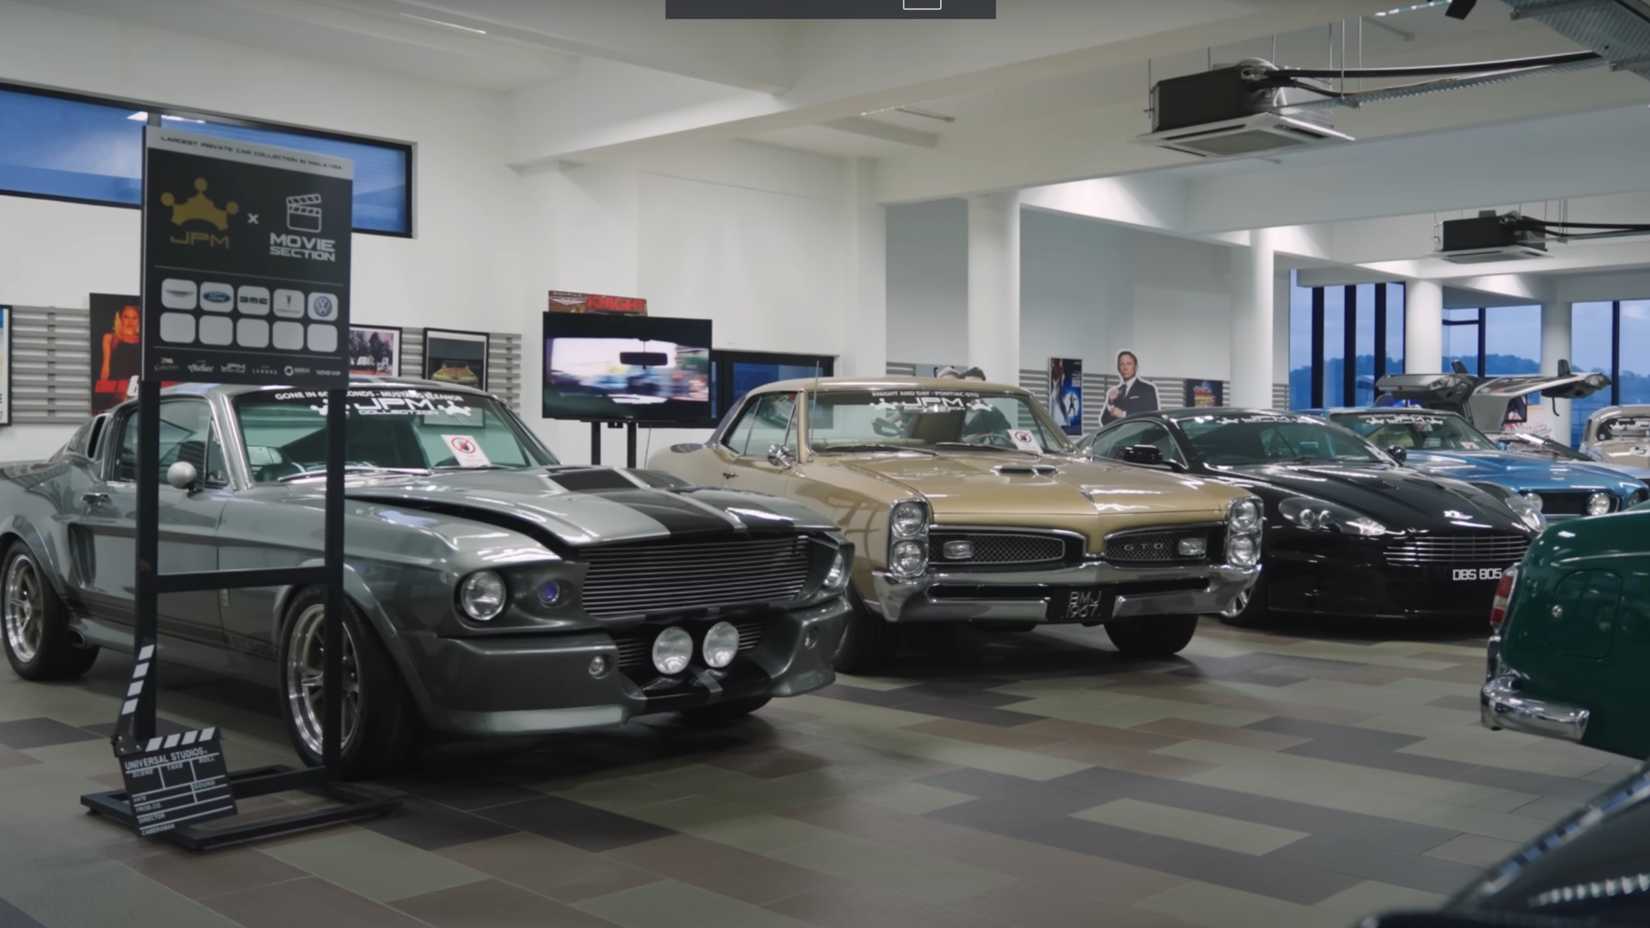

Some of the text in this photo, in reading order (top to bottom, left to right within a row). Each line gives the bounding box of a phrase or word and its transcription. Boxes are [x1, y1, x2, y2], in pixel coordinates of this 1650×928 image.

[254, 150, 299, 163] COLLECTION
[170, 232, 230, 249] JPM
[270, 232, 336, 252] MOVIE
[269, 245, 336, 262] SECTION
[274, 391, 305, 400] GONE
[353, 397, 435, 410] JPM
[902, 397, 965, 408] JPM
[1123, 543, 1164, 552] GTO
[1452, 567, 1502, 581] DBS 805
[125, 747, 204, 769] UNIVERSAL STUDIOS
